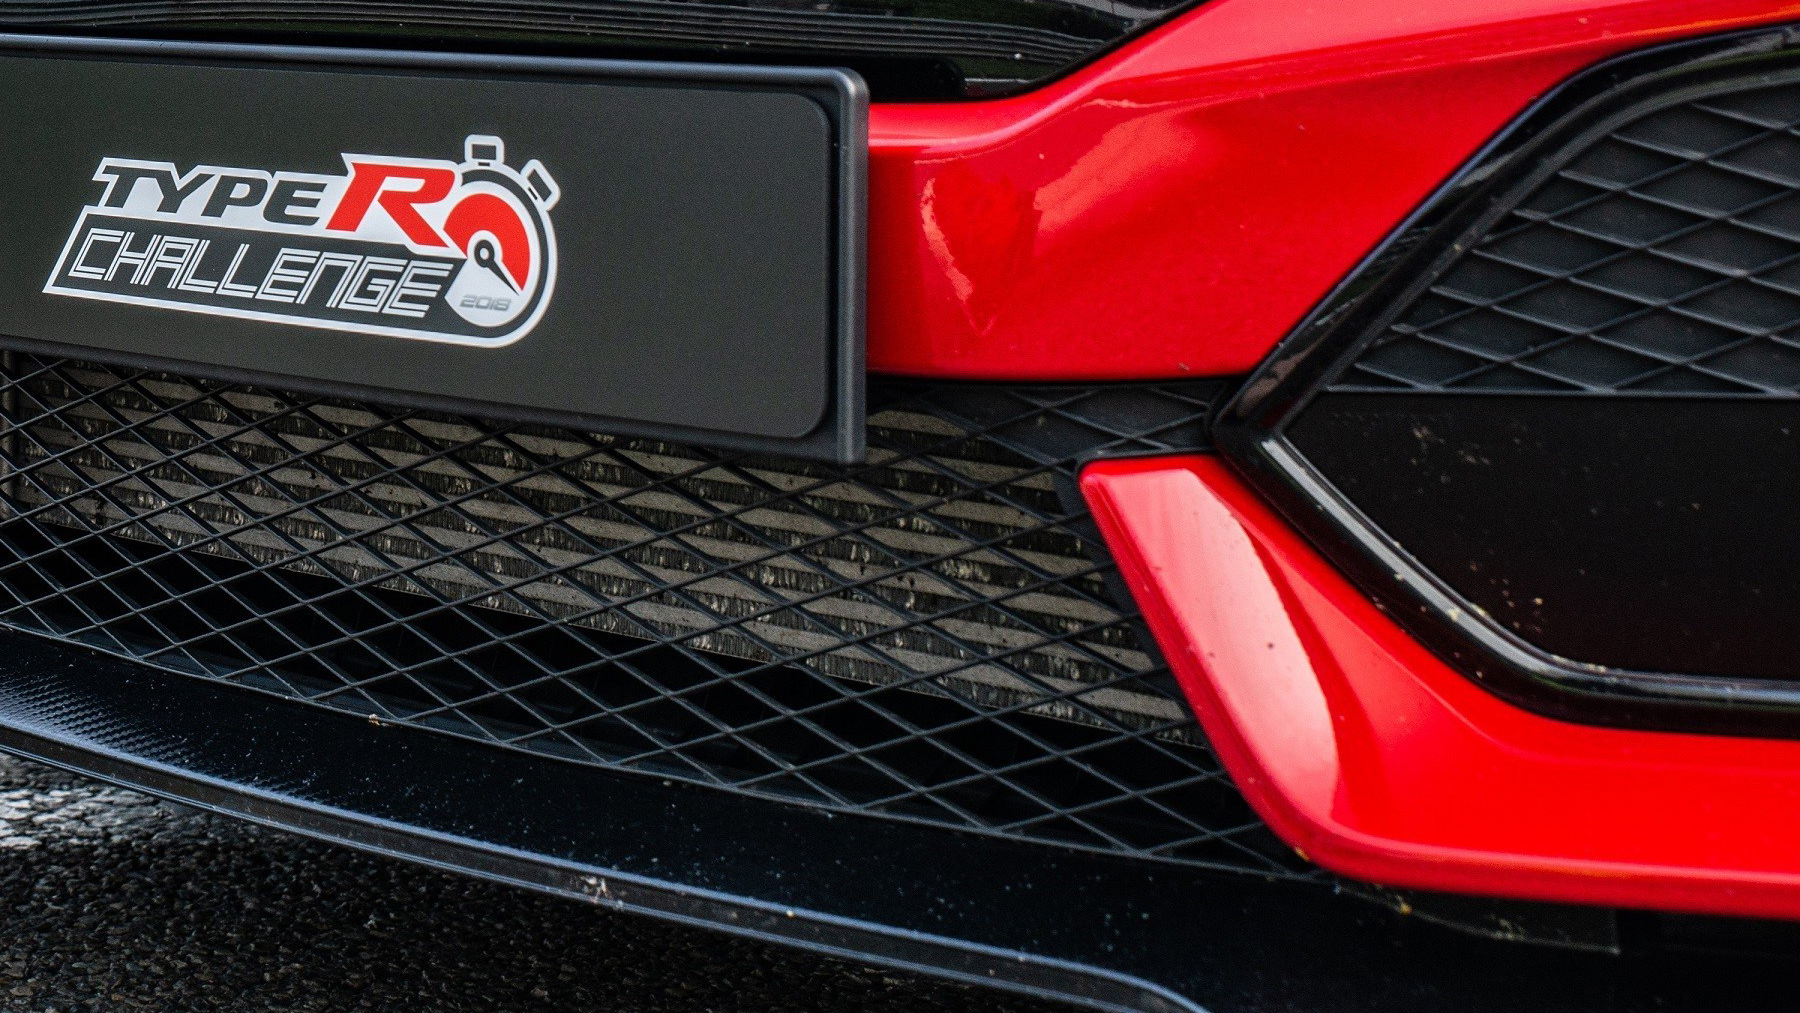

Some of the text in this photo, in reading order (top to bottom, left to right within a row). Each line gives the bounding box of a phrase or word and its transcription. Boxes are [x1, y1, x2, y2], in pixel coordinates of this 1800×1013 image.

[100, 161, 456, 248] TYPE R
[67, 227, 455, 319] CHALLENGE
[459, 293, 512, 312] 2018
